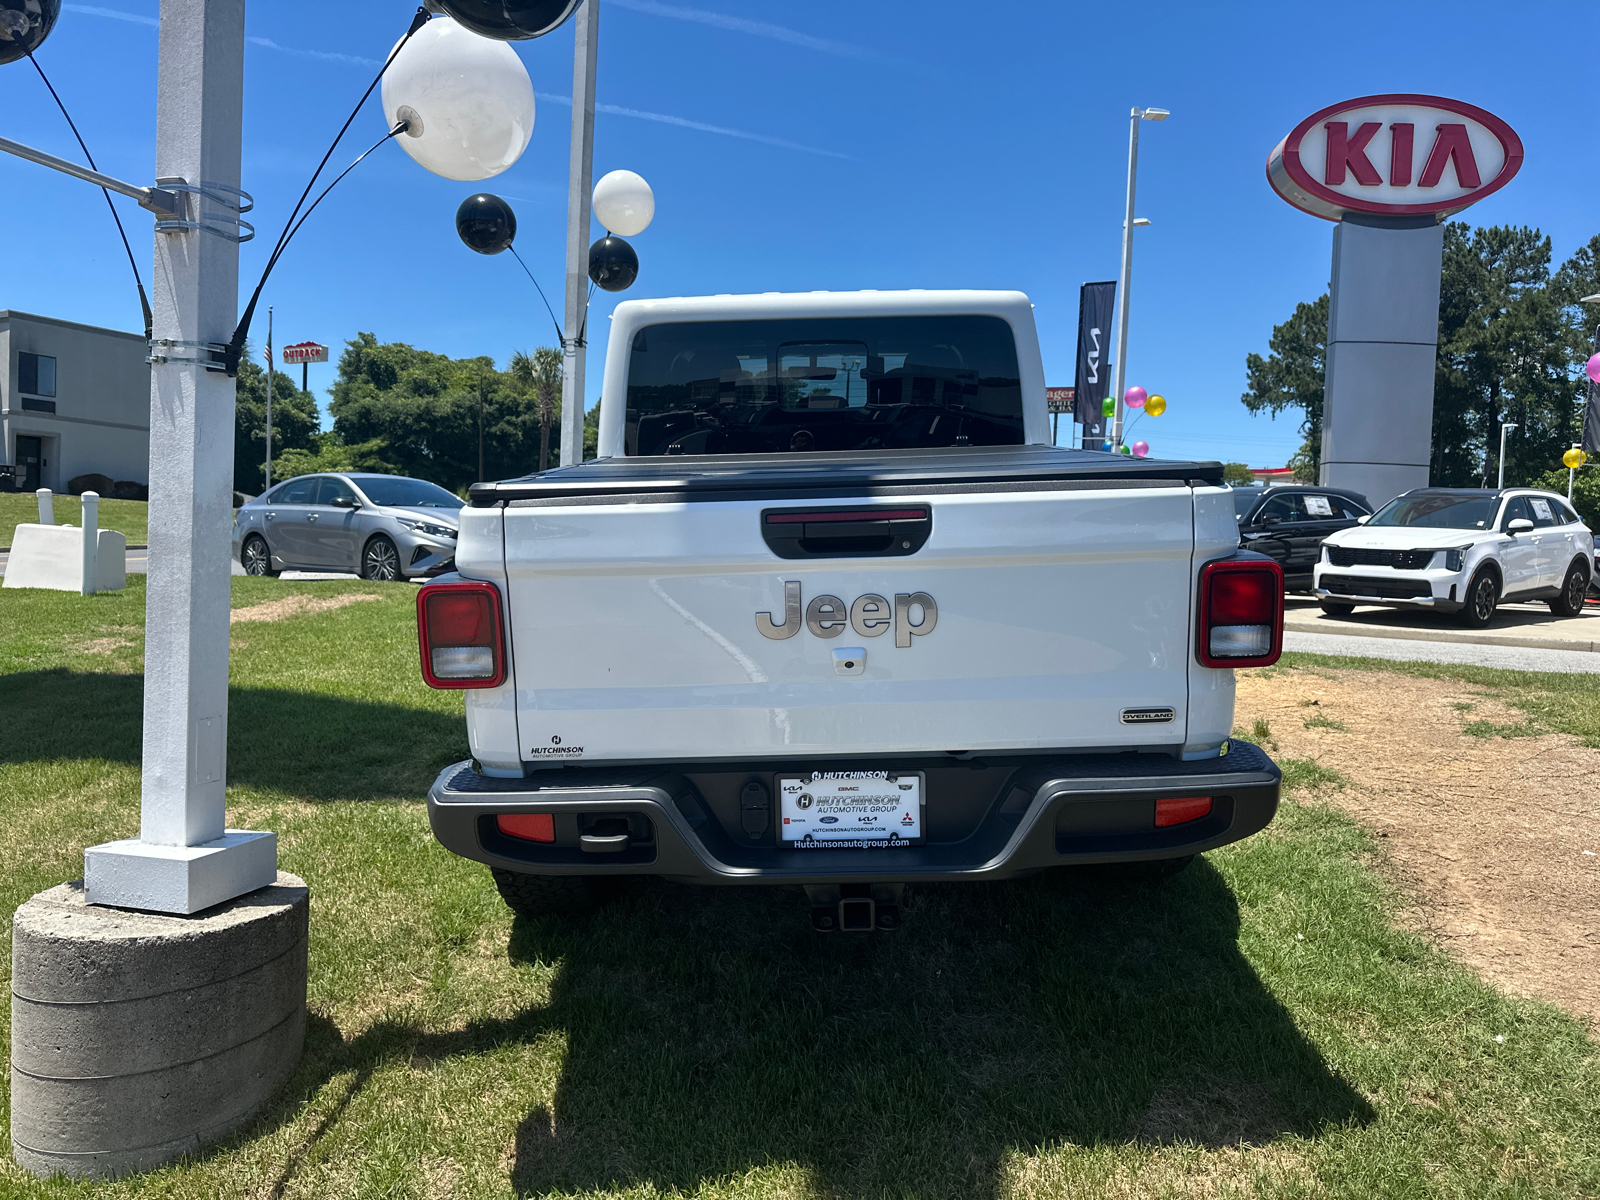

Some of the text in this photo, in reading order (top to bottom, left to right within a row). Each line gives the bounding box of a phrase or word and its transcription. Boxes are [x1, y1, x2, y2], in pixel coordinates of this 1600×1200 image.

[1324, 121, 1482, 189] KIA
[283, 348, 321, 358] OUTBACK
[755, 580, 938, 649] Jeep
[531, 746, 584, 754] HUTCHINSON
[823, 771, 889, 780] HUTCHINSON
[816, 794, 901, 807] HUTCHINSON
[817, 805, 898, 814] AUTOMOTIVE GROUP
[794, 839, 910, 849] Hutchinsonautogroup.com
